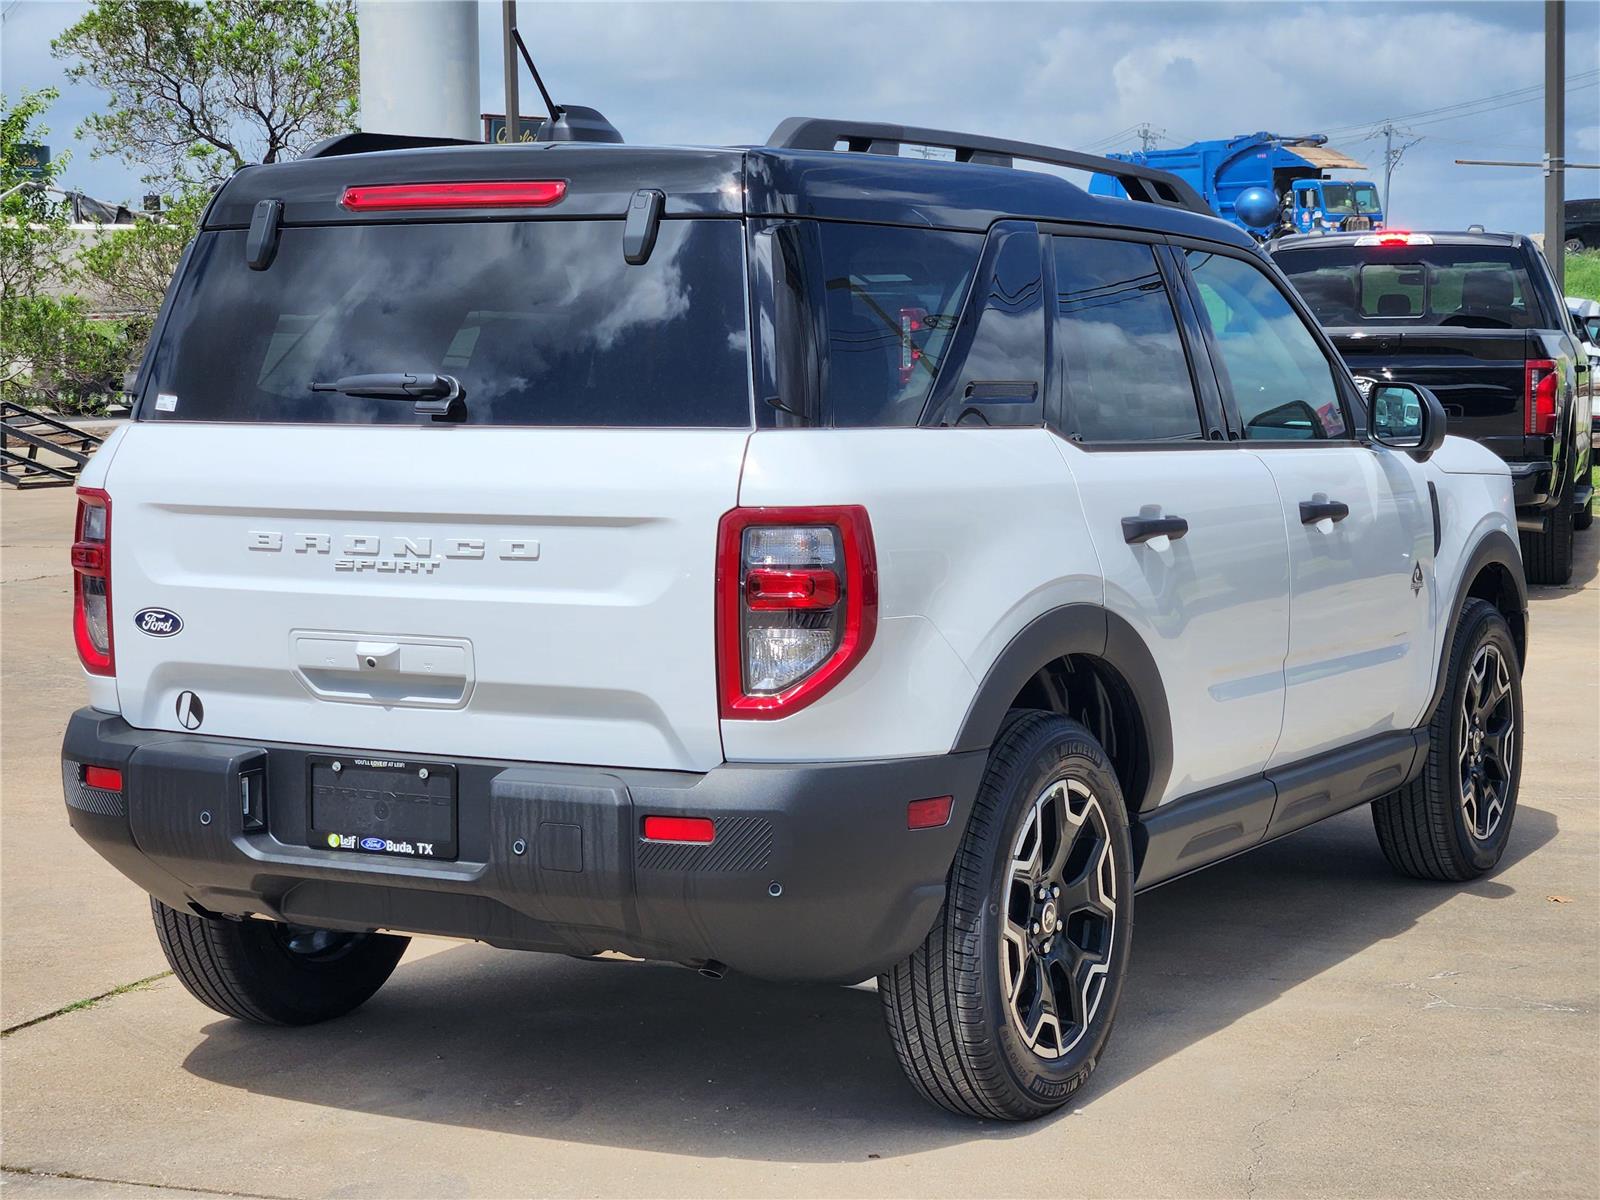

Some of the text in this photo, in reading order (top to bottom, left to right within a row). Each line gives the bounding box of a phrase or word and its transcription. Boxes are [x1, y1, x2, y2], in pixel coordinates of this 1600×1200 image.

[248, 530, 541, 561] BRONCO
[335, 558, 440, 574] SPORT
[142, 612, 173, 632] Ford
[1060, 741, 1102, 766] MICHELIN
[386, 840, 415, 855] Buda,
[416, 842, 434, 855] TX
[1032, 1077, 1079, 1096] MICHELIN
